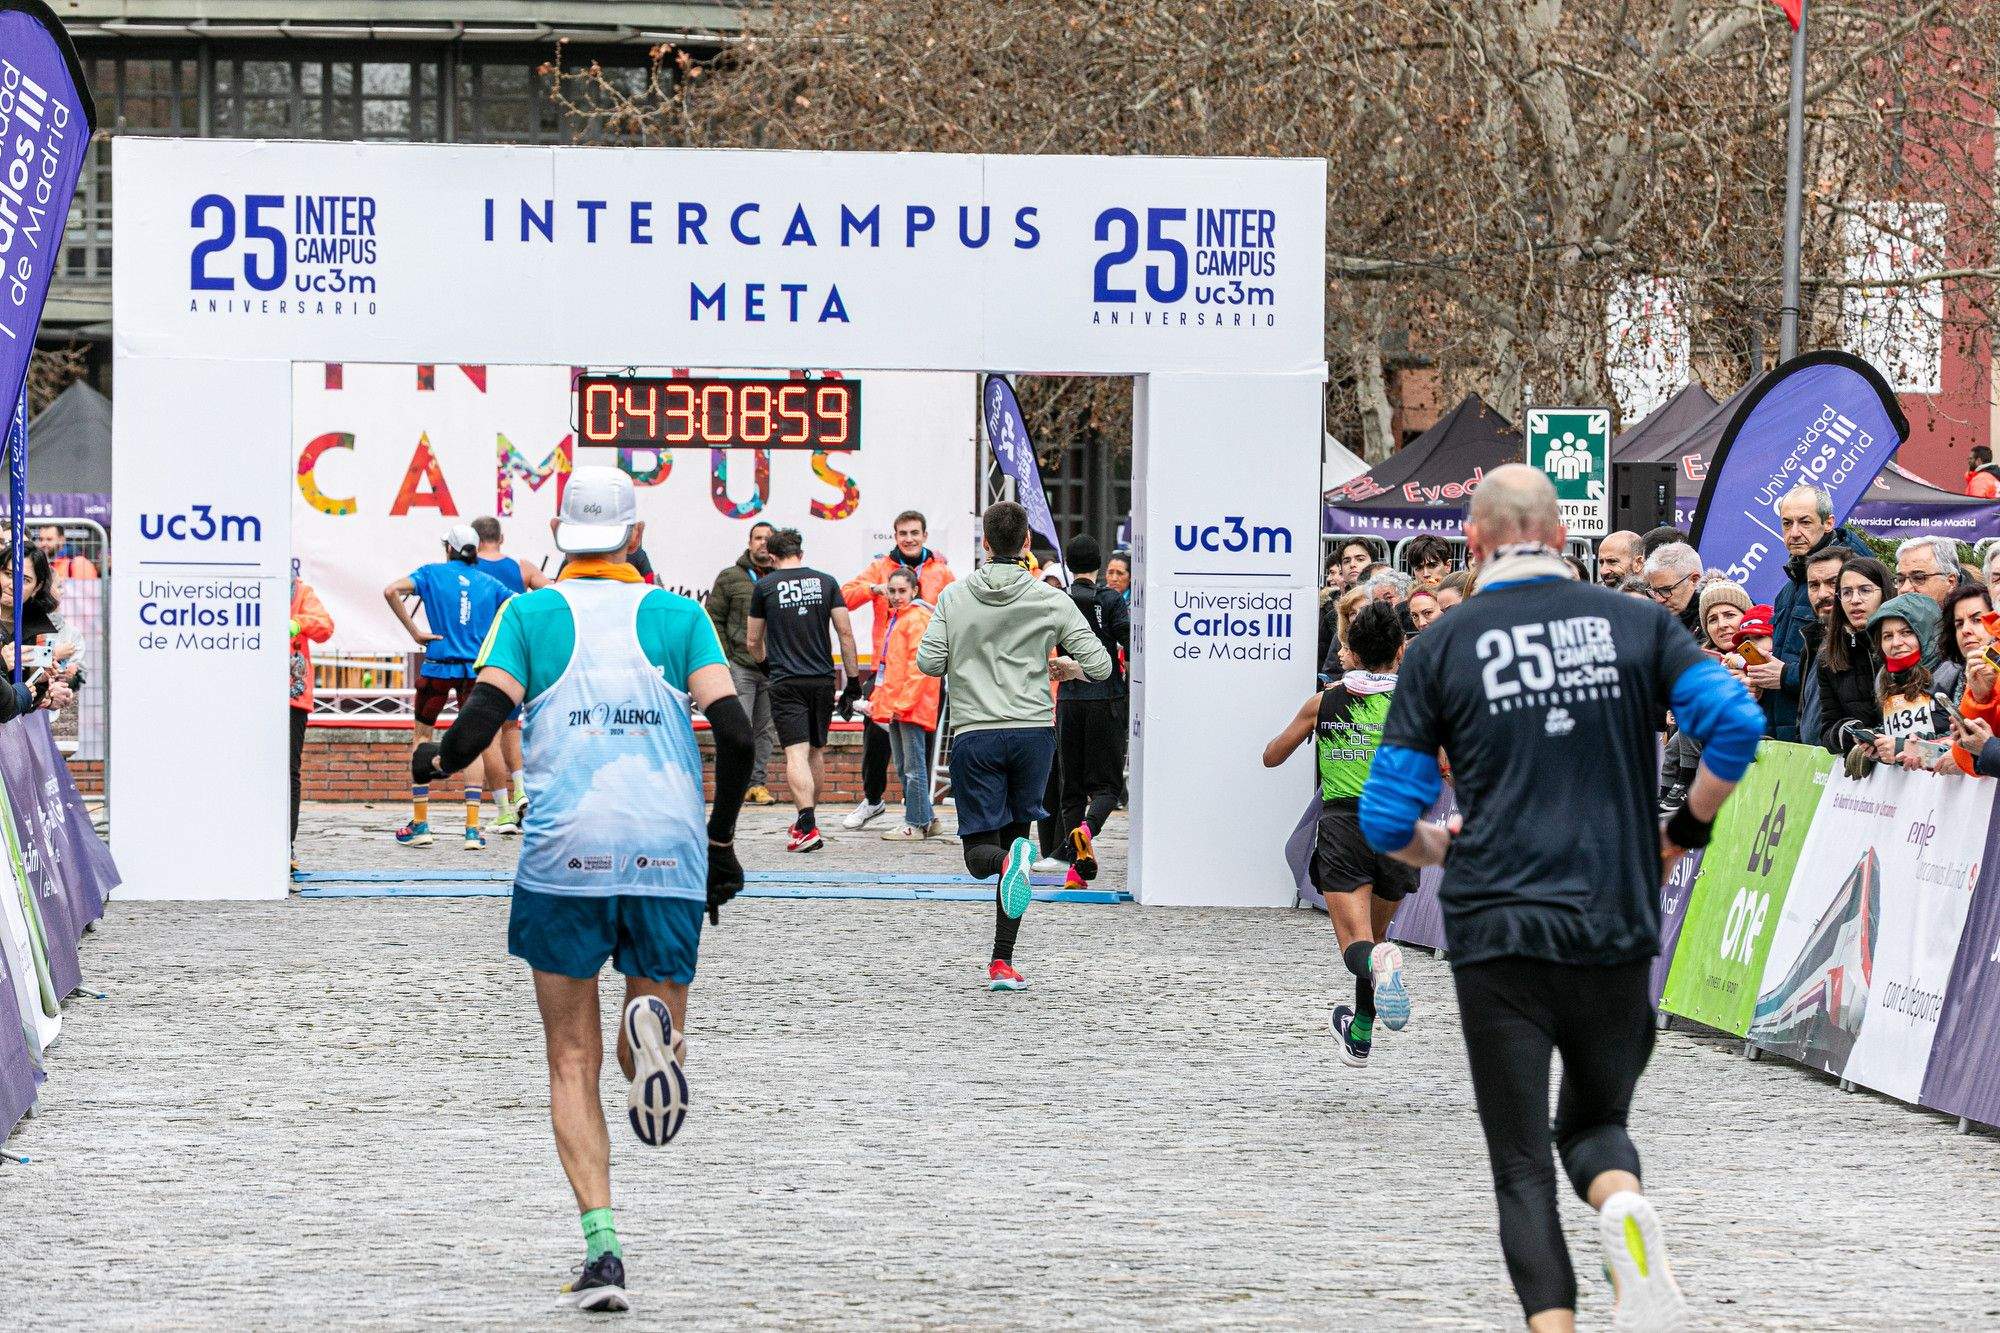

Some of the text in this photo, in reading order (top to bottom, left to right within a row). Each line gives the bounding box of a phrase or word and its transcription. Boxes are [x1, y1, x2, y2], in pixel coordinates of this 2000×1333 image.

[15, 75, 47, 132] III
[0, 133, 34, 278] arlos
[9, 97, 70, 307] de Madrid
[484, 198, 1041, 250] INTERCAMPUS
[190, 193, 376, 292] 25 INTER
[295, 237, 376, 264] CAMPUS
[1093, 207, 1276, 303] 25 INTER
[1195, 250, 1276, 276] CAMPUS
[295, 268, 376, 293] uc3m
[1195, 280, 1274, 306] uc3m
[190, 299, 376, 315] ANIVERSARIO
[690, 281, 850, 323] META
[1093, 310, 1275, 327] ANIVERSARIO
[1825, 414, 1858, 446] III
[1754, 403, 1838, 506] Universidad
[583, 502, 602, 515] edp
[1583, 505, 1598, 516] DE
[140, 505, 261, 541] uc3m
[1174, 516, 1292, 553] uc3m
[1894, 517, 1921, 527] Carlos
[1931, 518, 1943, 527] de
[1944, 518, 1976, 527] Madrid
[139, 581, 261, 599] Universidad
[777, 580, 802, 604] 25
[1174, 590, 1292, 610] Universidad
[139, 602, 261, 627] Carlos III
[1174, 612, 1291, 637] Carlos III
[139, 632, 261, 651] de Madrid
[1173, 641, 1291, 661] de Madrid
[1475, 616, 1614, 701] 25 INTER
[1553, 643, 1617, 668] CAMPUS
[1556, 664, 1620, 688] uc3m
[568, 709, 591, 726] 21K
[1887, 706, 1929, 735] 1434
[1350, 734, 1372, 746] DE
[1747, 779, 1786, 877] be
[1720, 887, 1770, 966] one
[1882, 981, 1902, 1011] con
[1906, 977, 1943, 1028] deporte
